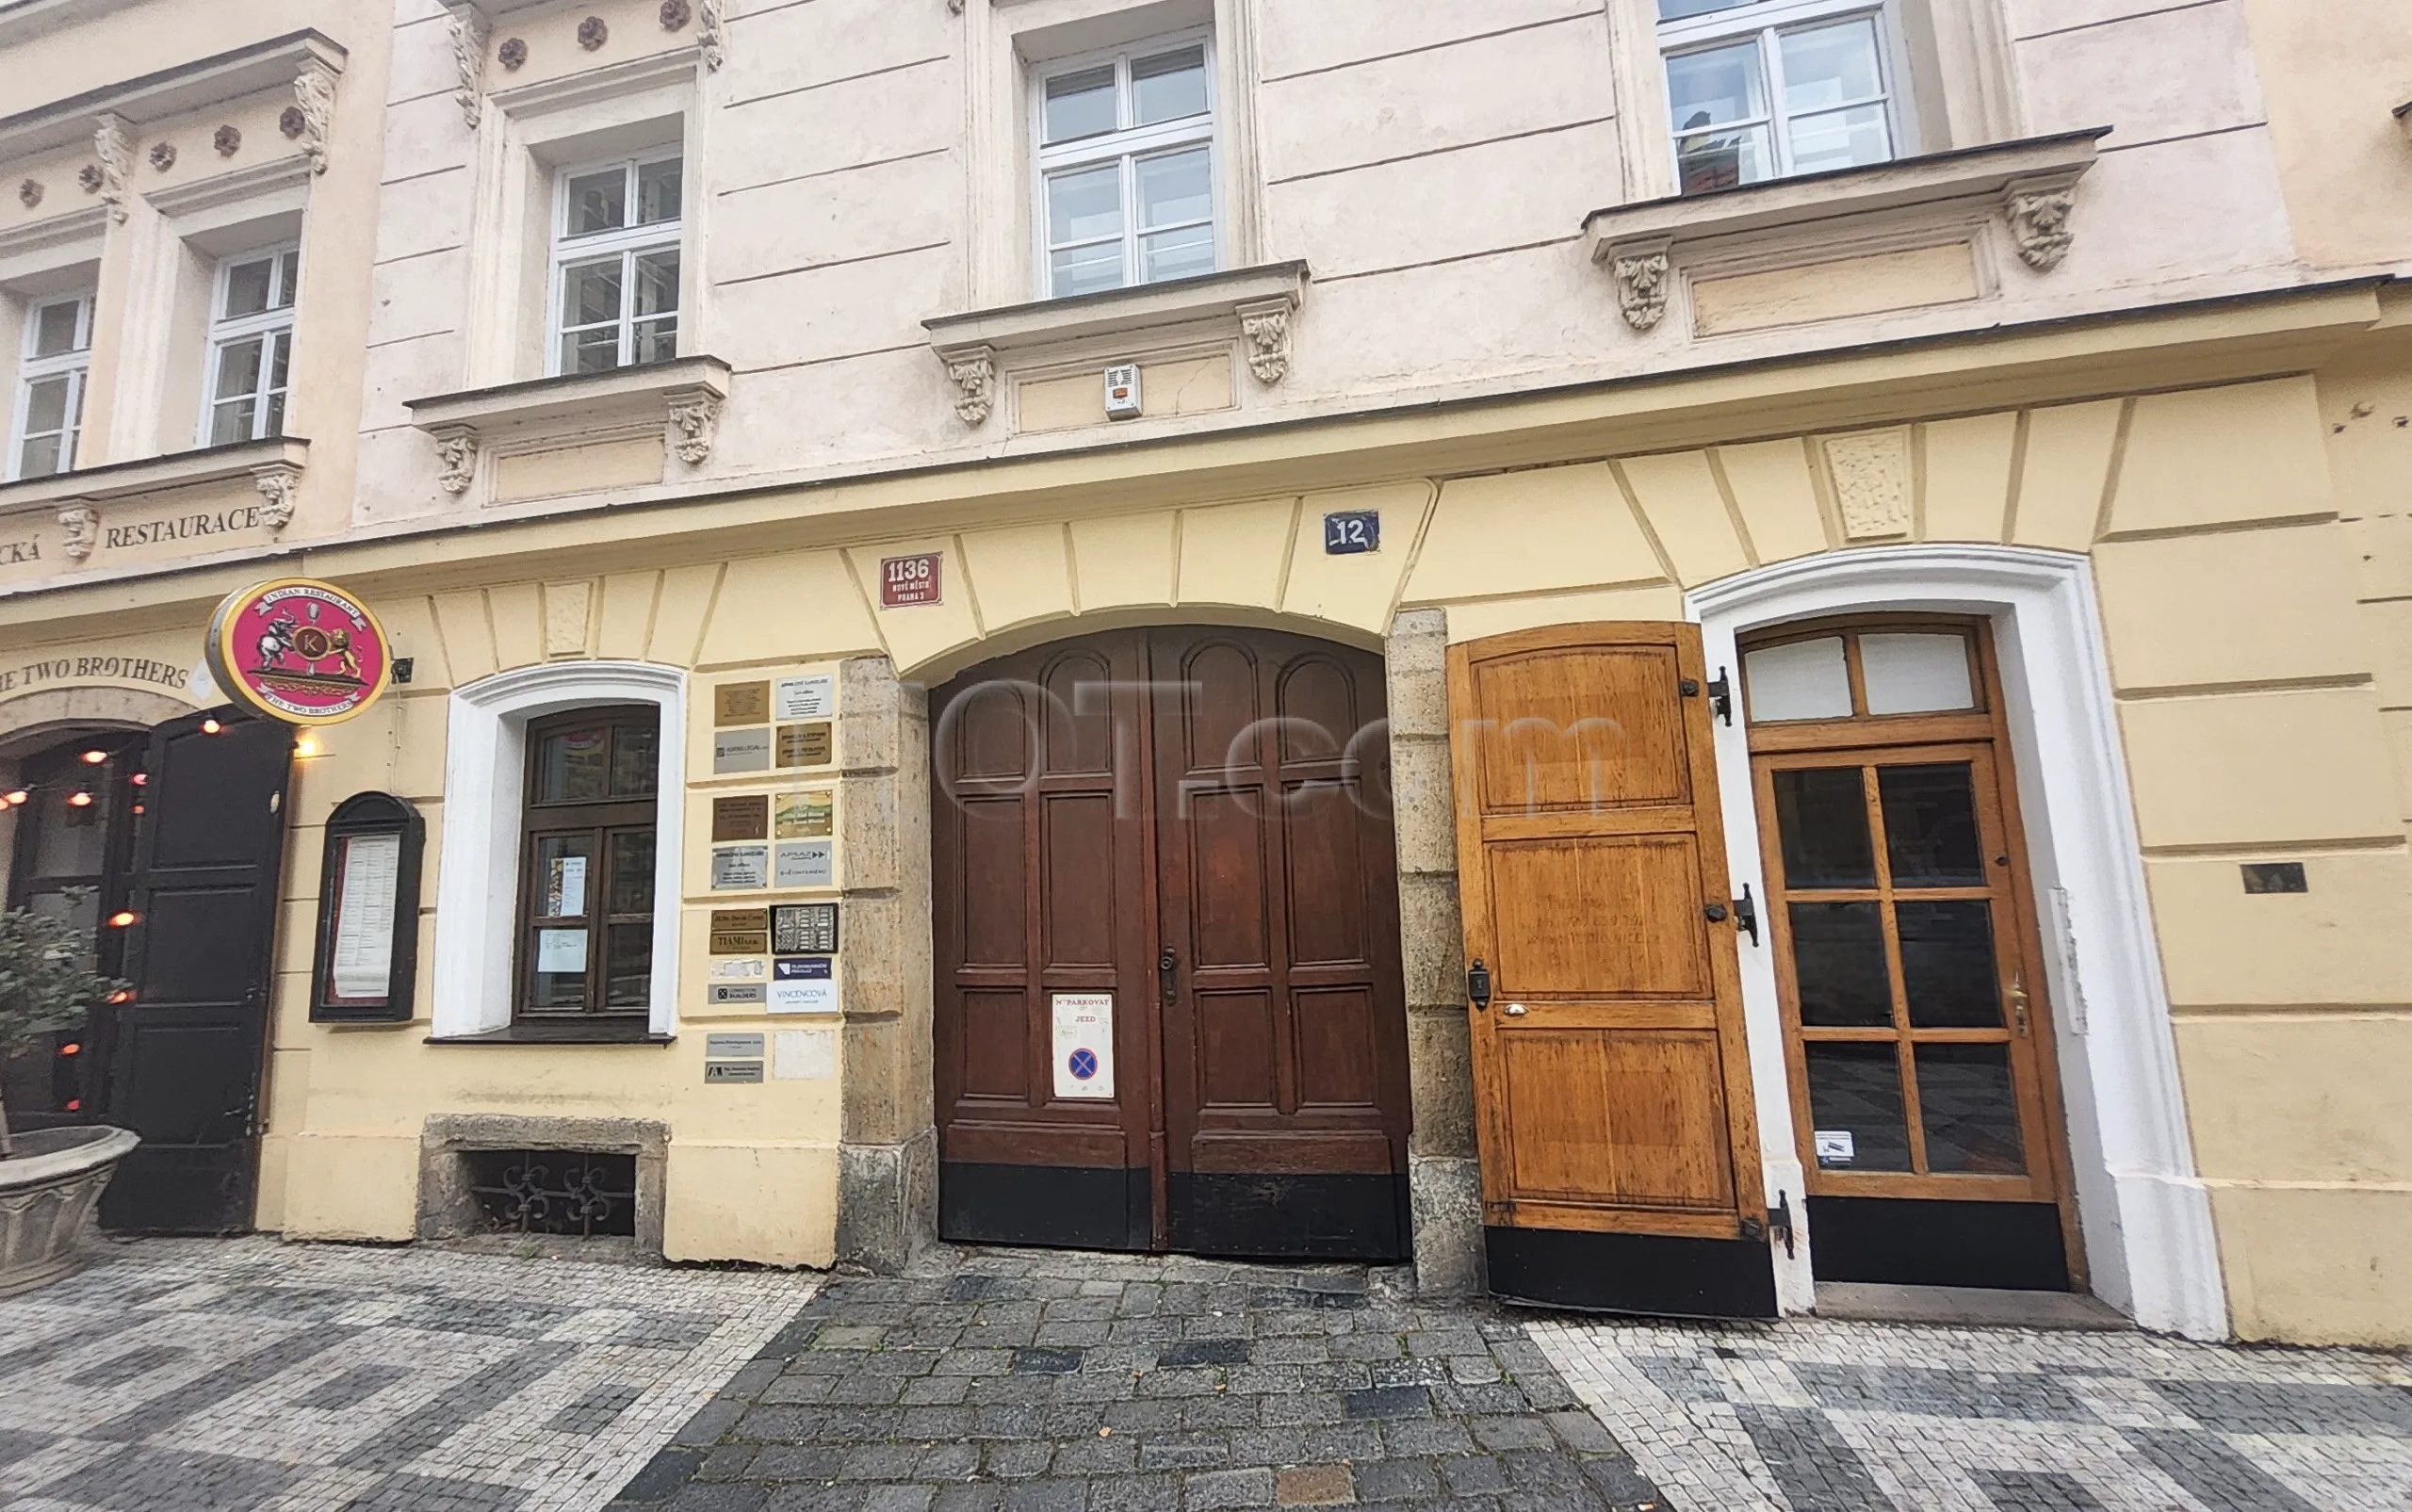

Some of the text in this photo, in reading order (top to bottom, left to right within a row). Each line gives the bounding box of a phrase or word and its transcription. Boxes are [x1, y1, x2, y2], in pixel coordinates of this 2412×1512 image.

[106, 506, 260, 548] RESTAURACE
[1337, 519, 1366, 545] 12
[888, 559, 930, 582] 1136
[267, 588, 358, 618] INDIAN RESTAURANT
[303, 634, 318, 652] K
[21, 659, 71, 685] TWO
[73, 657, 189, 691] BROTHERS
[267, 693, 353, 715] THE TWO BROTHERS
